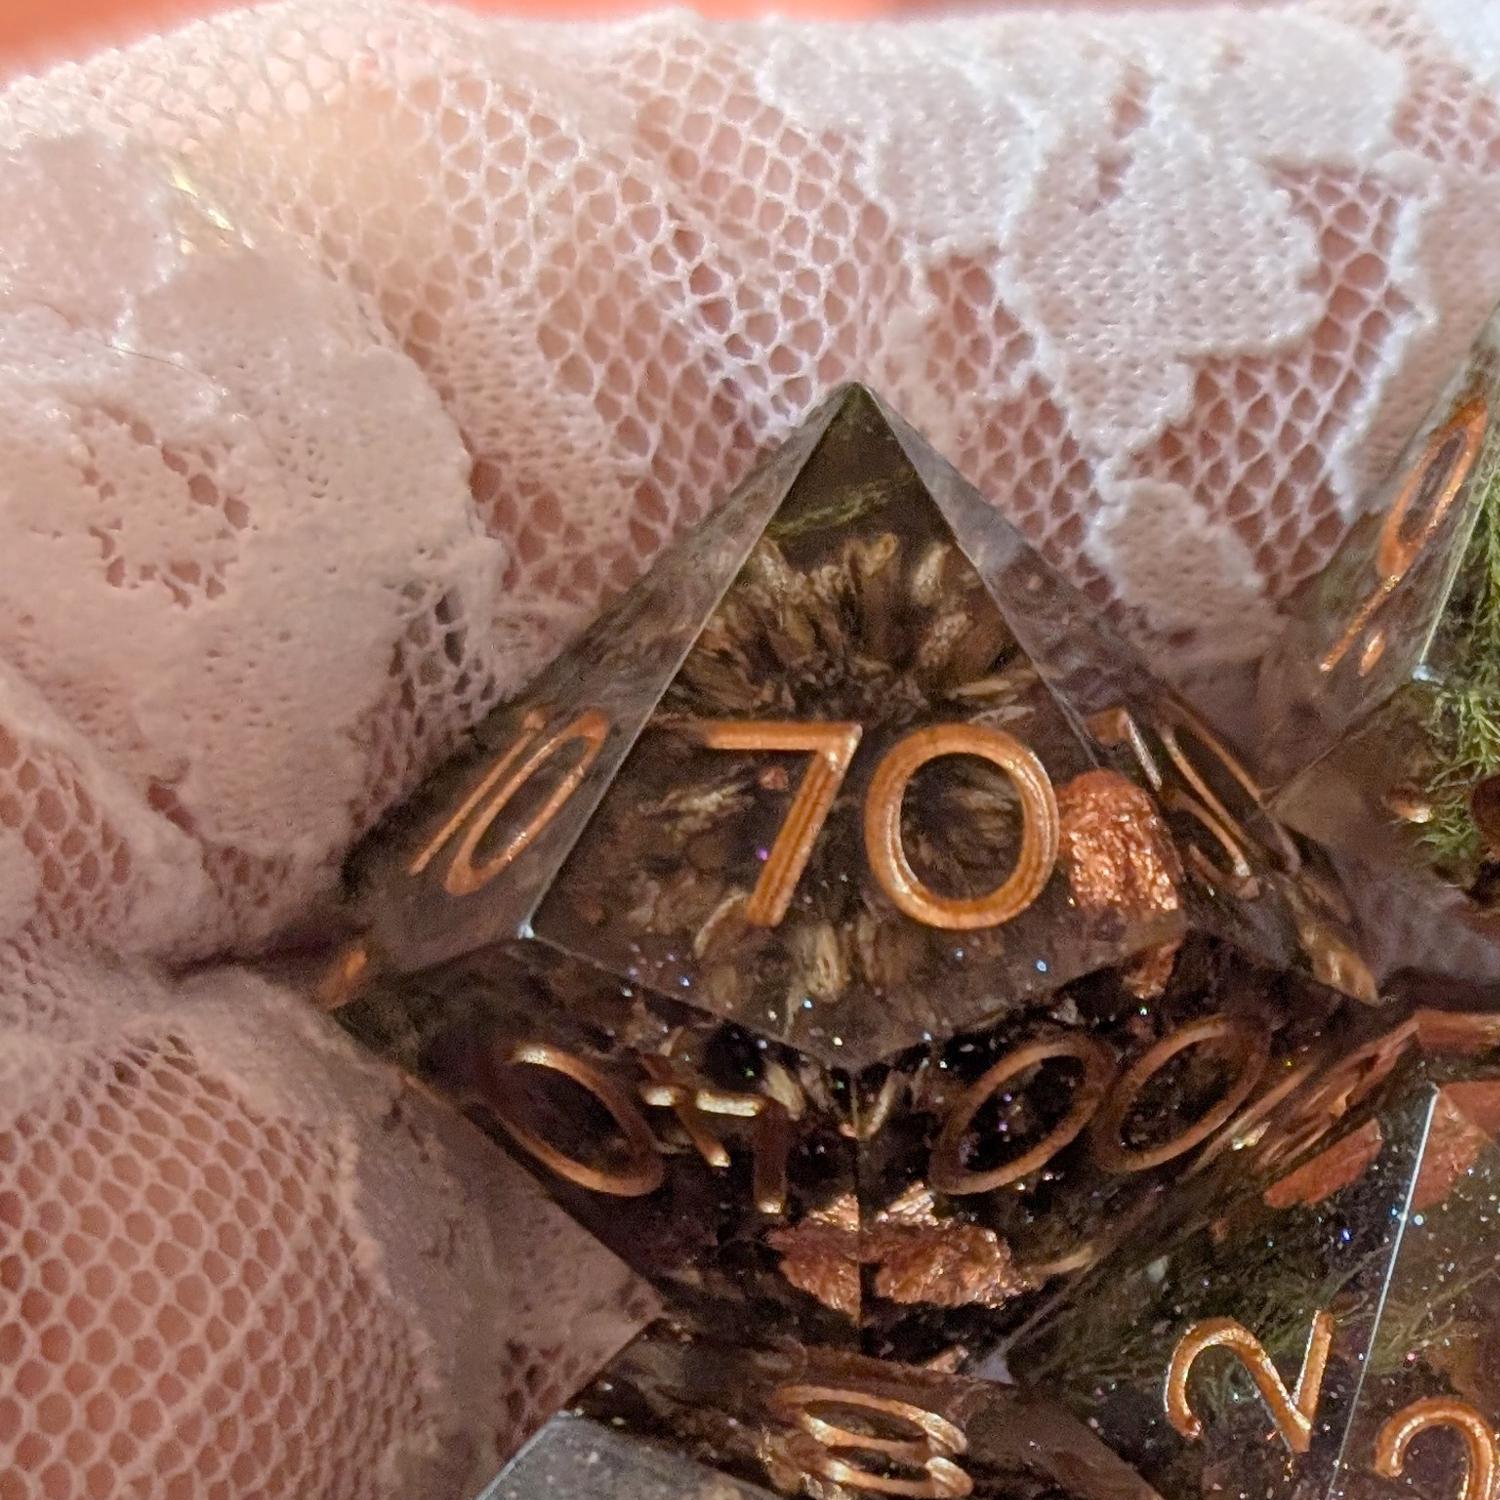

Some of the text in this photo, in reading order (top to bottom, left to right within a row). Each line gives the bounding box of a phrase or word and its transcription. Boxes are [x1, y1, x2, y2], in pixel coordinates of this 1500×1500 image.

[408, 706, 611, 897] 10
[700, 721, 1060, 930] 70
[1163, 1308, 1338, 1454] 2
